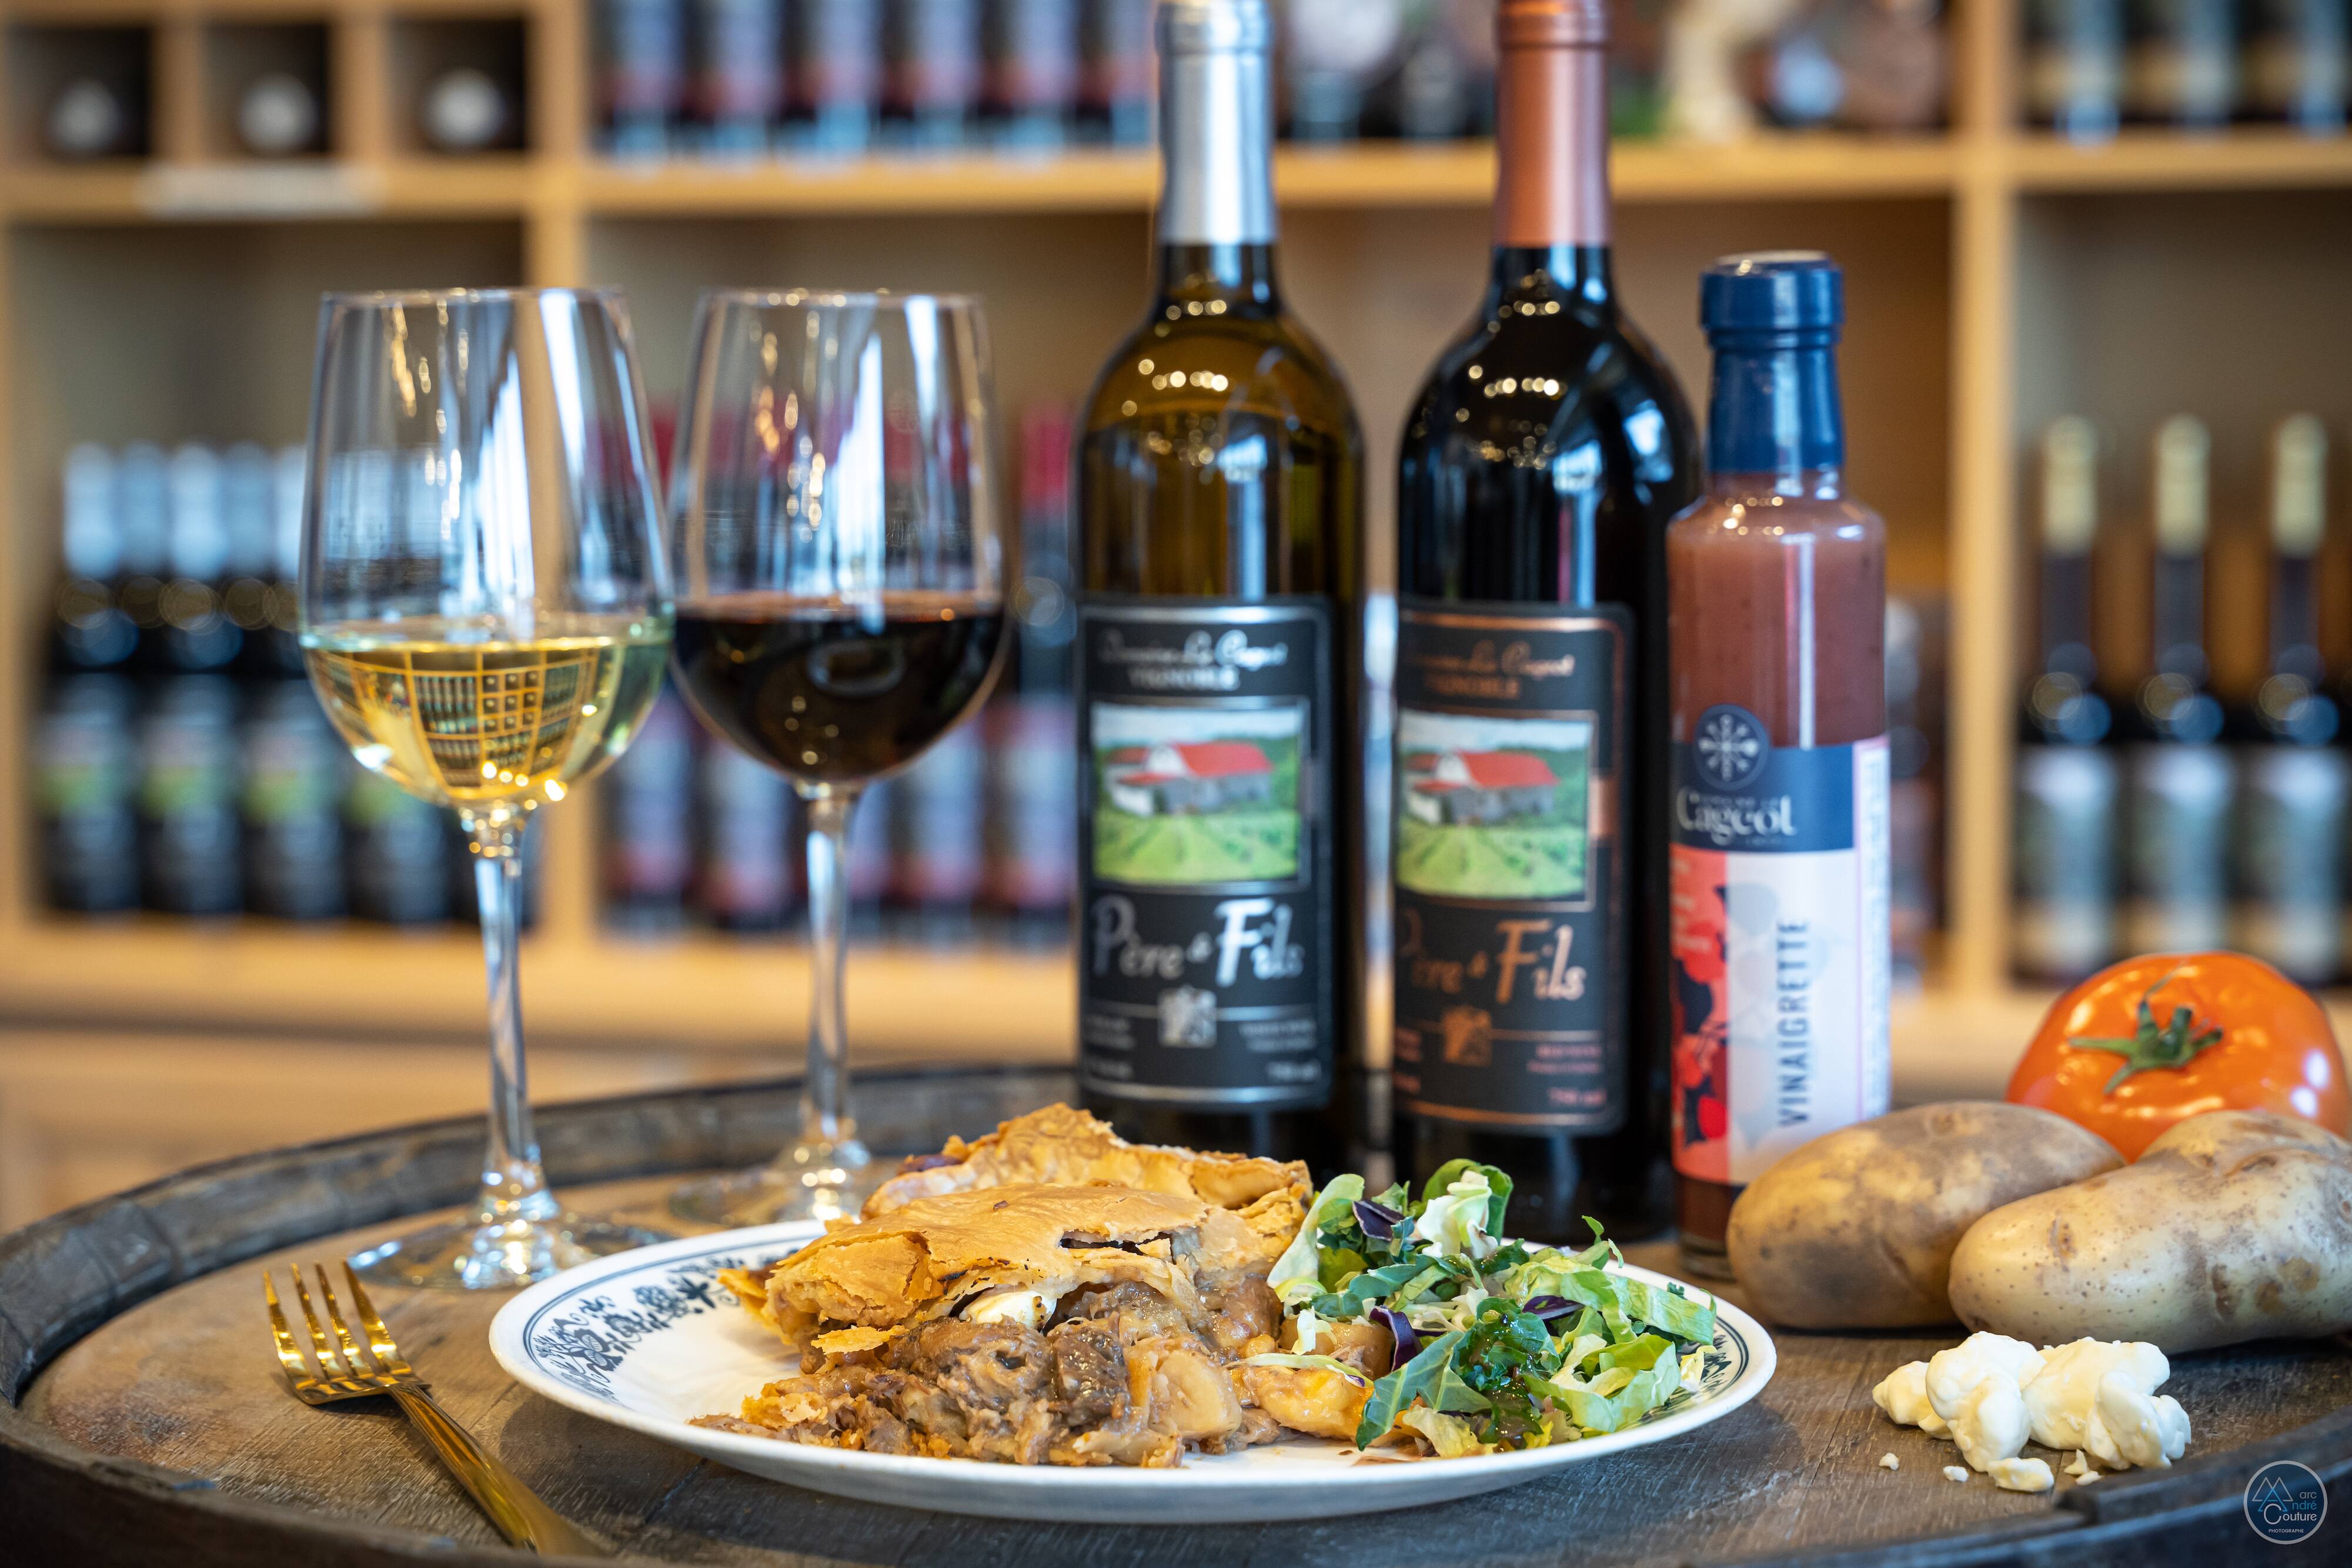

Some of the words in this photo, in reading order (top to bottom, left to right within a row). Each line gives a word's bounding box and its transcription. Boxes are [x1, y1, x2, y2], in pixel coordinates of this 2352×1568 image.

[1215, 897, 1305, 987] Fils
[1496, 918, 1588, 1004] Fils
[1776, 921, 1812, 1128] VINAIGRETTE
